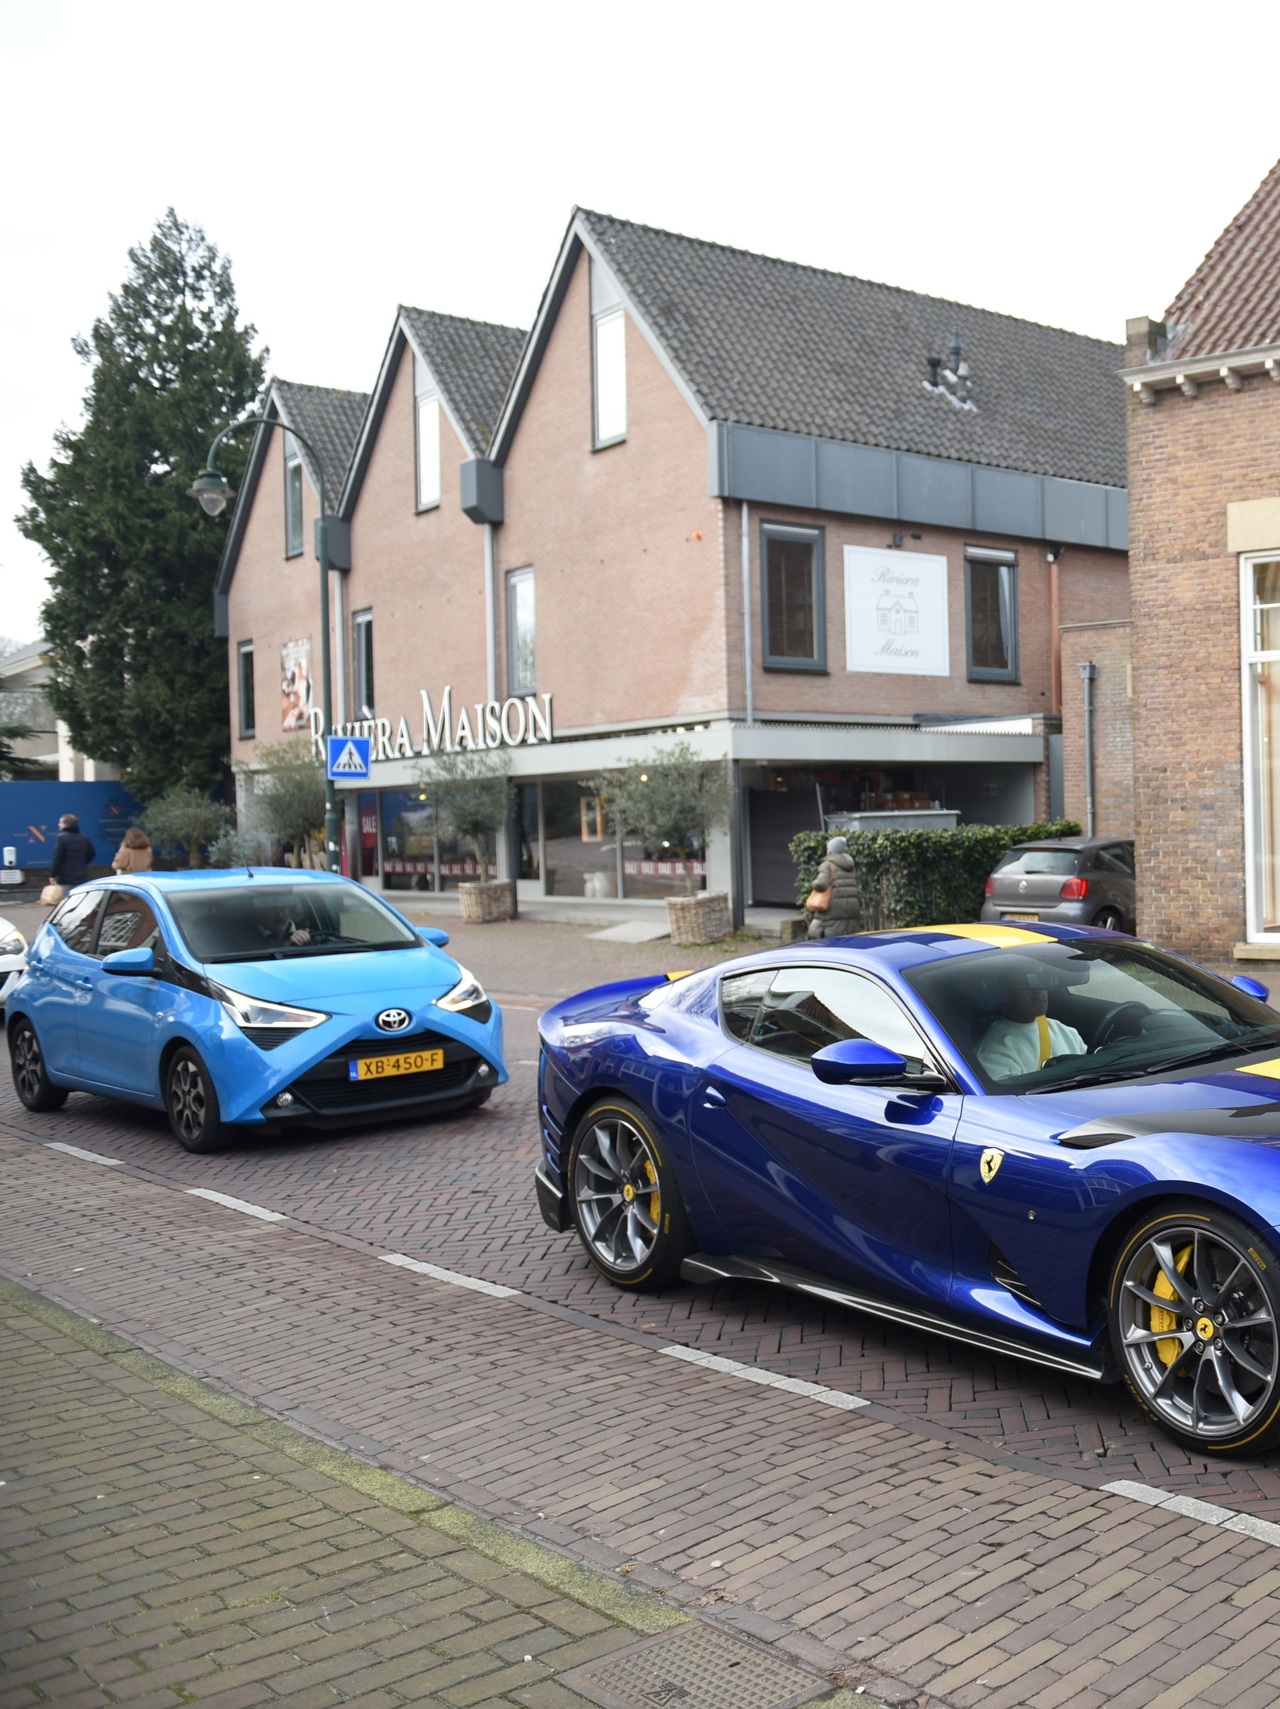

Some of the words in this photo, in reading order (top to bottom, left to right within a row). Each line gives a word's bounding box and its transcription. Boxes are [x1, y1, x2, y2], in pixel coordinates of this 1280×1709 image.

[874, 638, 920, 658] Maison
[420, 685, 553, 756] MAISON
[362, 815, 377, 834] SALE
